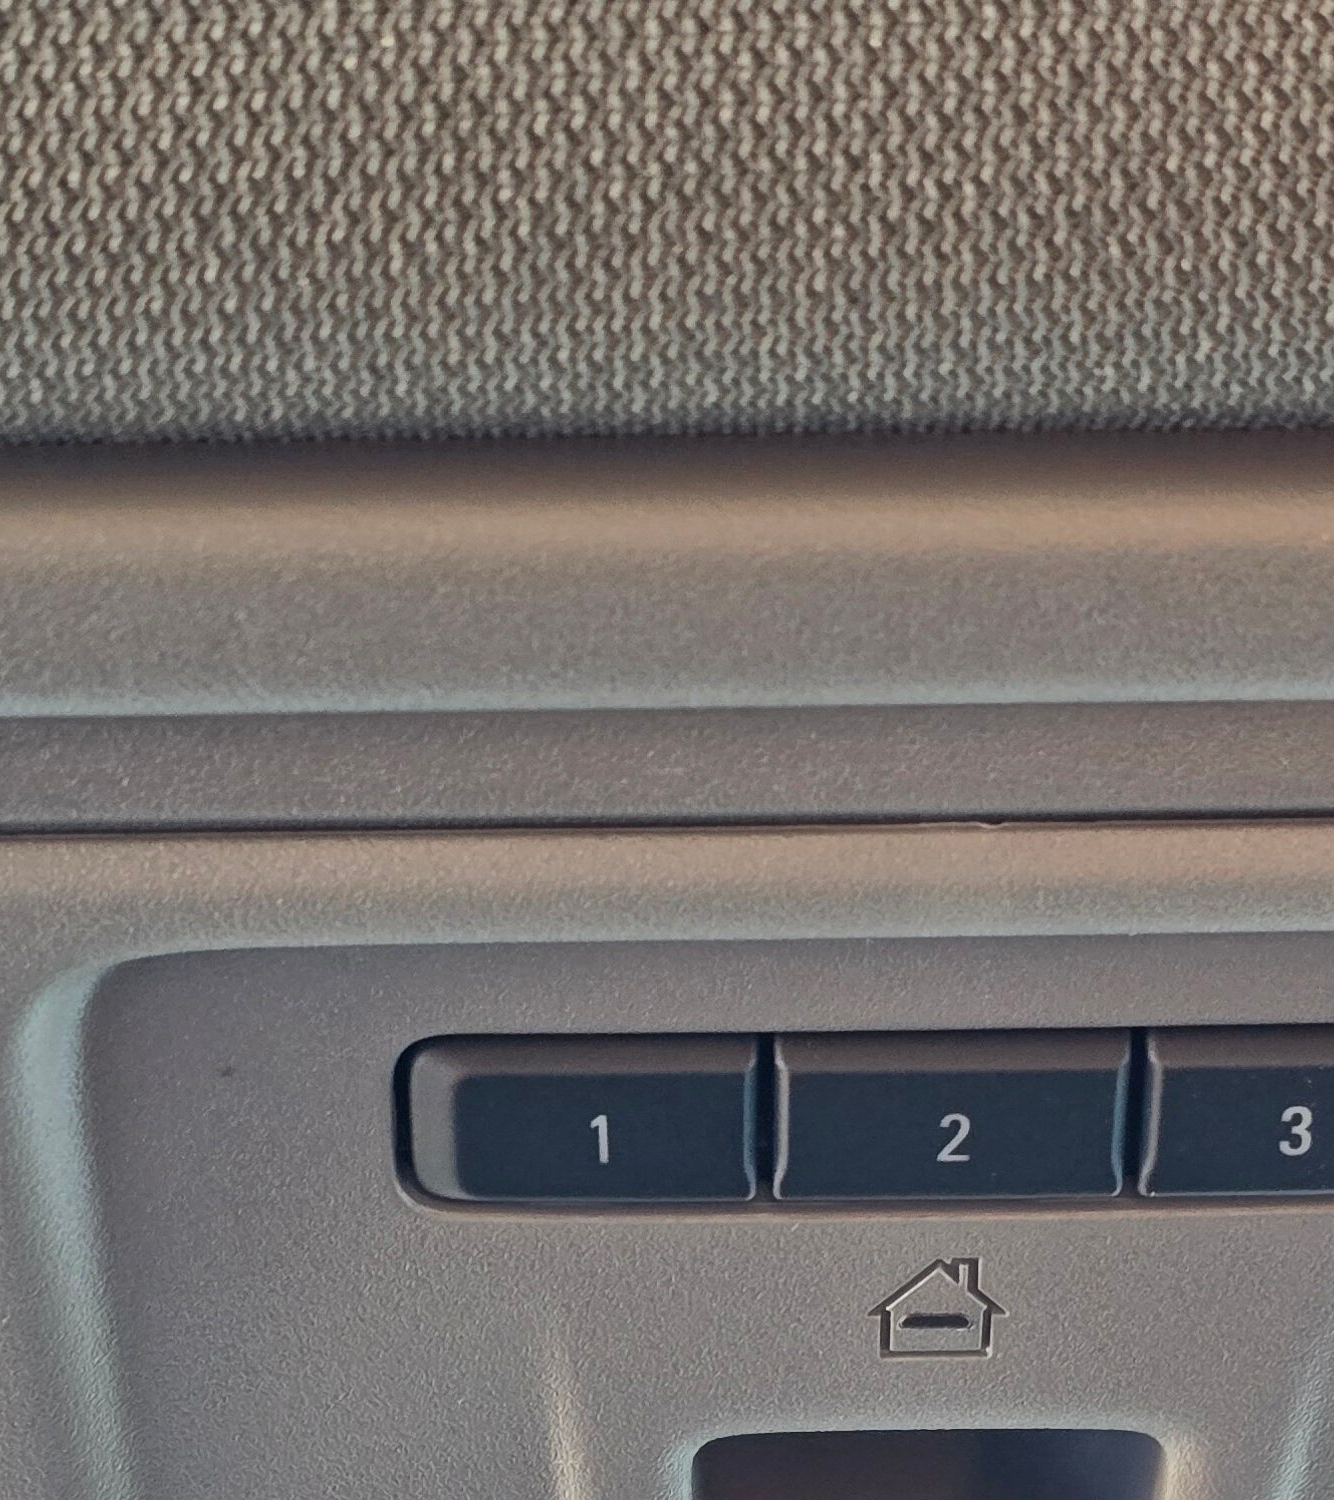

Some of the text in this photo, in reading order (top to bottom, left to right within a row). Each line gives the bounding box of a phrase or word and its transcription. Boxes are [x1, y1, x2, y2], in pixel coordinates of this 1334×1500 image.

[588, 1114, 610, 1165] 1
[937, 1113, 972, 1162] 2
[1278, 1106, 1313, 1157] 3
